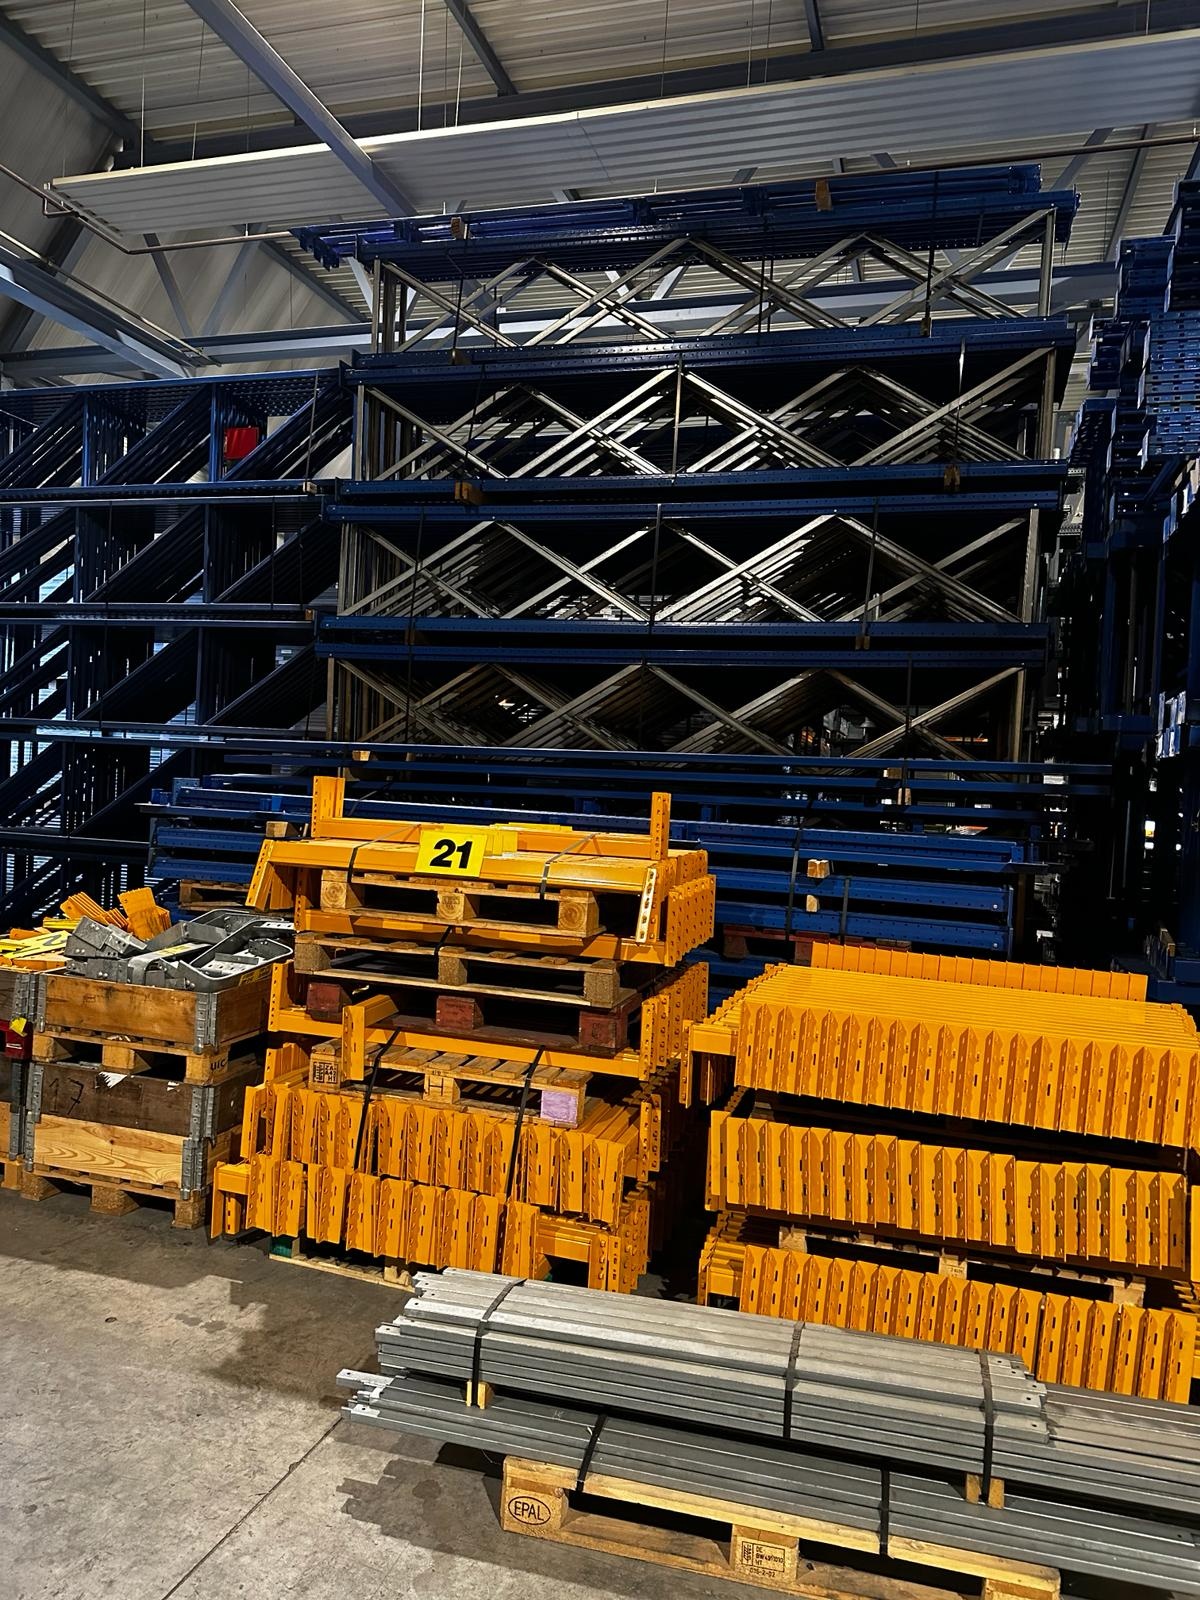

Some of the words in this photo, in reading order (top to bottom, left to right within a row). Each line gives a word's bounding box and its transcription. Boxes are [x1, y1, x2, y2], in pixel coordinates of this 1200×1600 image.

[429, 838, 473, 869] 21
[48, 1078, 84, 1115] 17
[514, 1500, 545, 1521] EPAL
